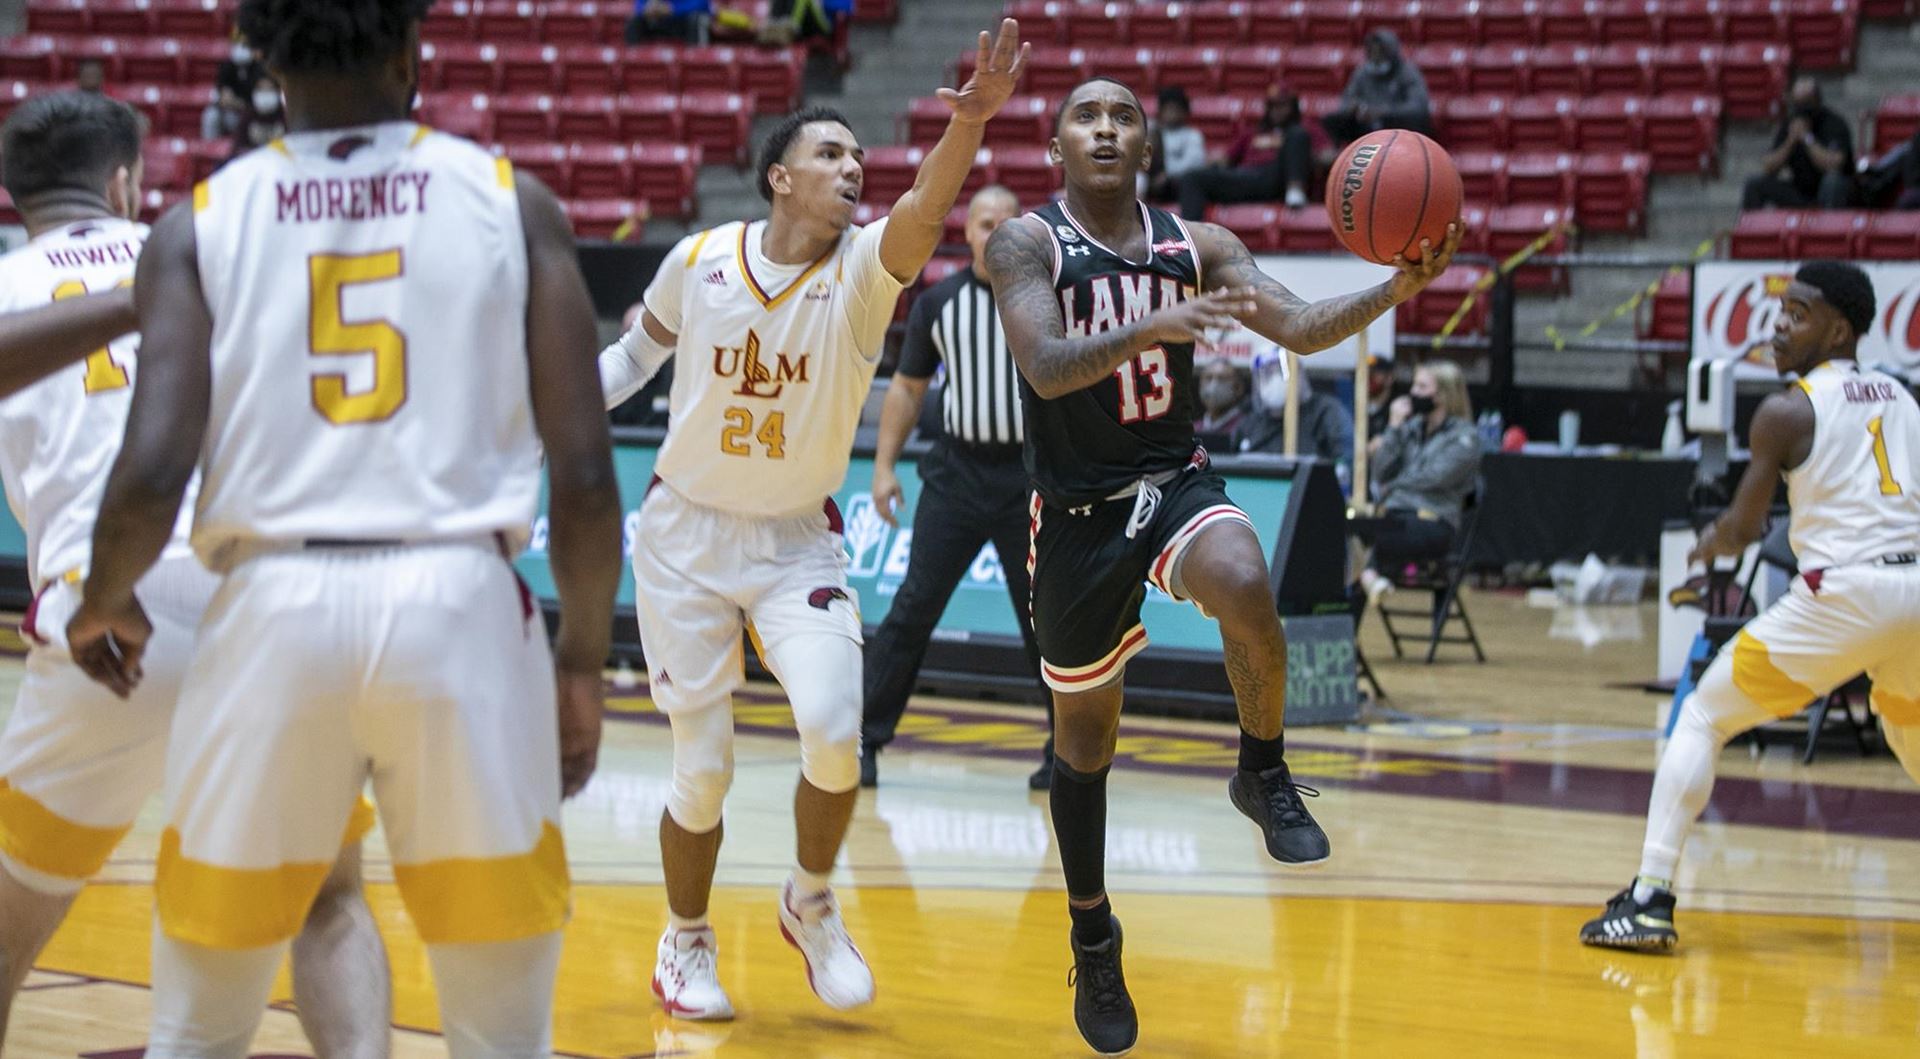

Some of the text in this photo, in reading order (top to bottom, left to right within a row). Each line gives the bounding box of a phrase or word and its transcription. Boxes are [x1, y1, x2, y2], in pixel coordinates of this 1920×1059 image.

[275, 171, 431, 223] MORENCY
[1342, 144, 1381, 232] Wilson
[46, 240, 135, 269] HOWEL
[307, 246, 409, 426] 5
[1061, 272, 1196, 340] LAMA
[713, 327, 811, 399] ULM
[1113, 344, 1174, 424] 13
[720, 406, 786, 459] 24
[1866, 414, 1904, 497] 1
